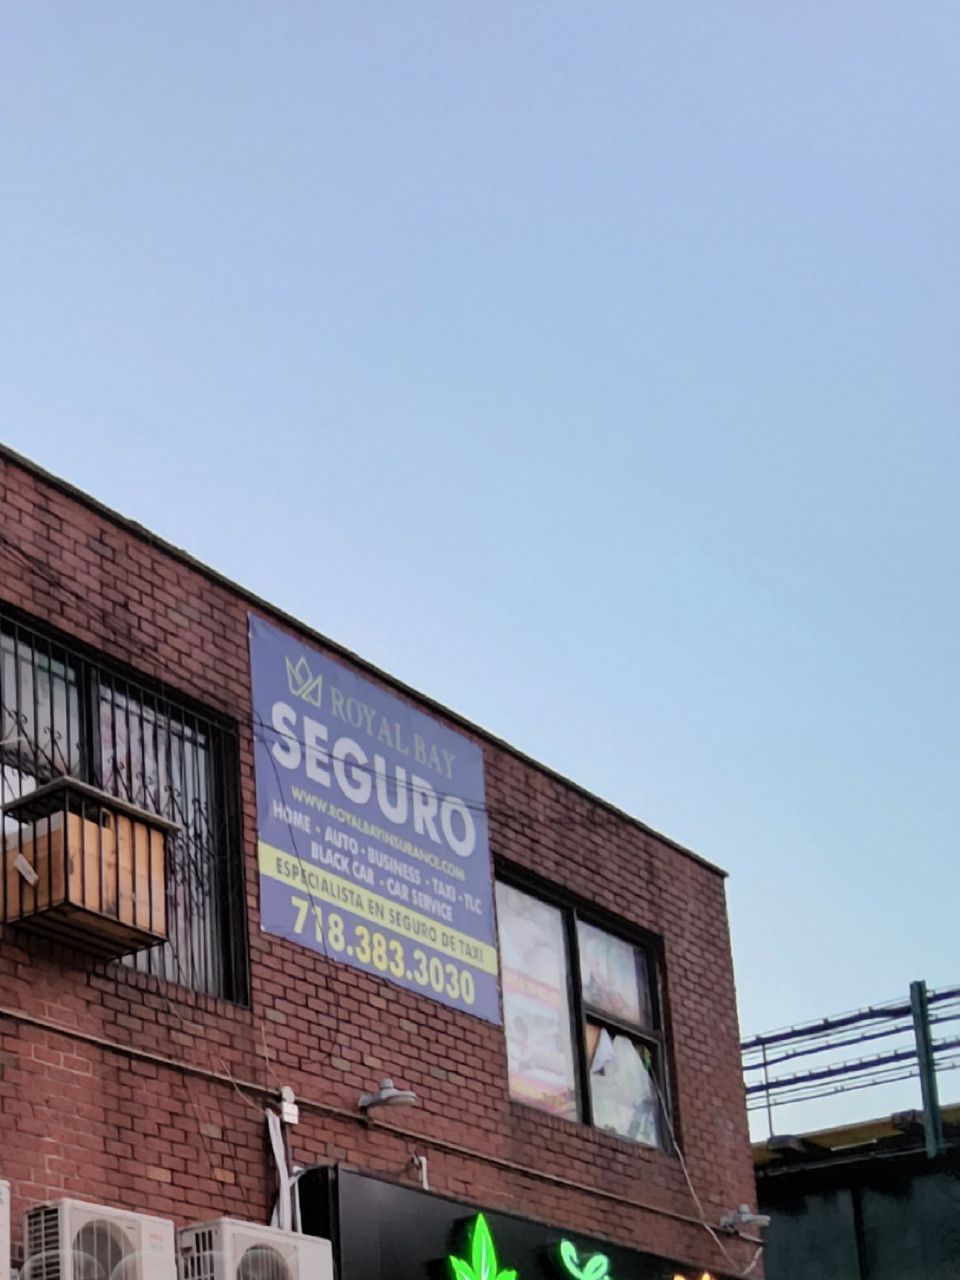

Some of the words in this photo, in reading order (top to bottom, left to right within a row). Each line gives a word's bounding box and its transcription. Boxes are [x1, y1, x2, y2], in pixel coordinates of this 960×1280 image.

[271, 701, 476, 858] SEGURO
[330, 686, 410, 756] ROYAL
[414, 733, 456, 780] BAY
[272, 800, 311, 834] HOME
[325, 826, 359, 855] AUTO
[368, 846, 421, 885] BUSINESS
[431, 878, 457, 902] TAXI
[464, 893, 483, 915] TLC
[291, 785, 465, 881] WWW.ROYALBAYINSURANCE.COM
[311, 841, 350, 876] BLACK
[352, 860, 374, 886] CAR
[386, 879, 409, 901] CAR
[411, 889, 453, 922] SERVICE
[276, 857, 365, 911] ESPECIALISTA
[368, 898, 385, 920] EN
[389, 908, 437, 942] SEGURO
[441, 932, 455, 949] DE
[460, 938, 484, 962] TAXI
[291, 896, 476, 1005] 718.383.3030
